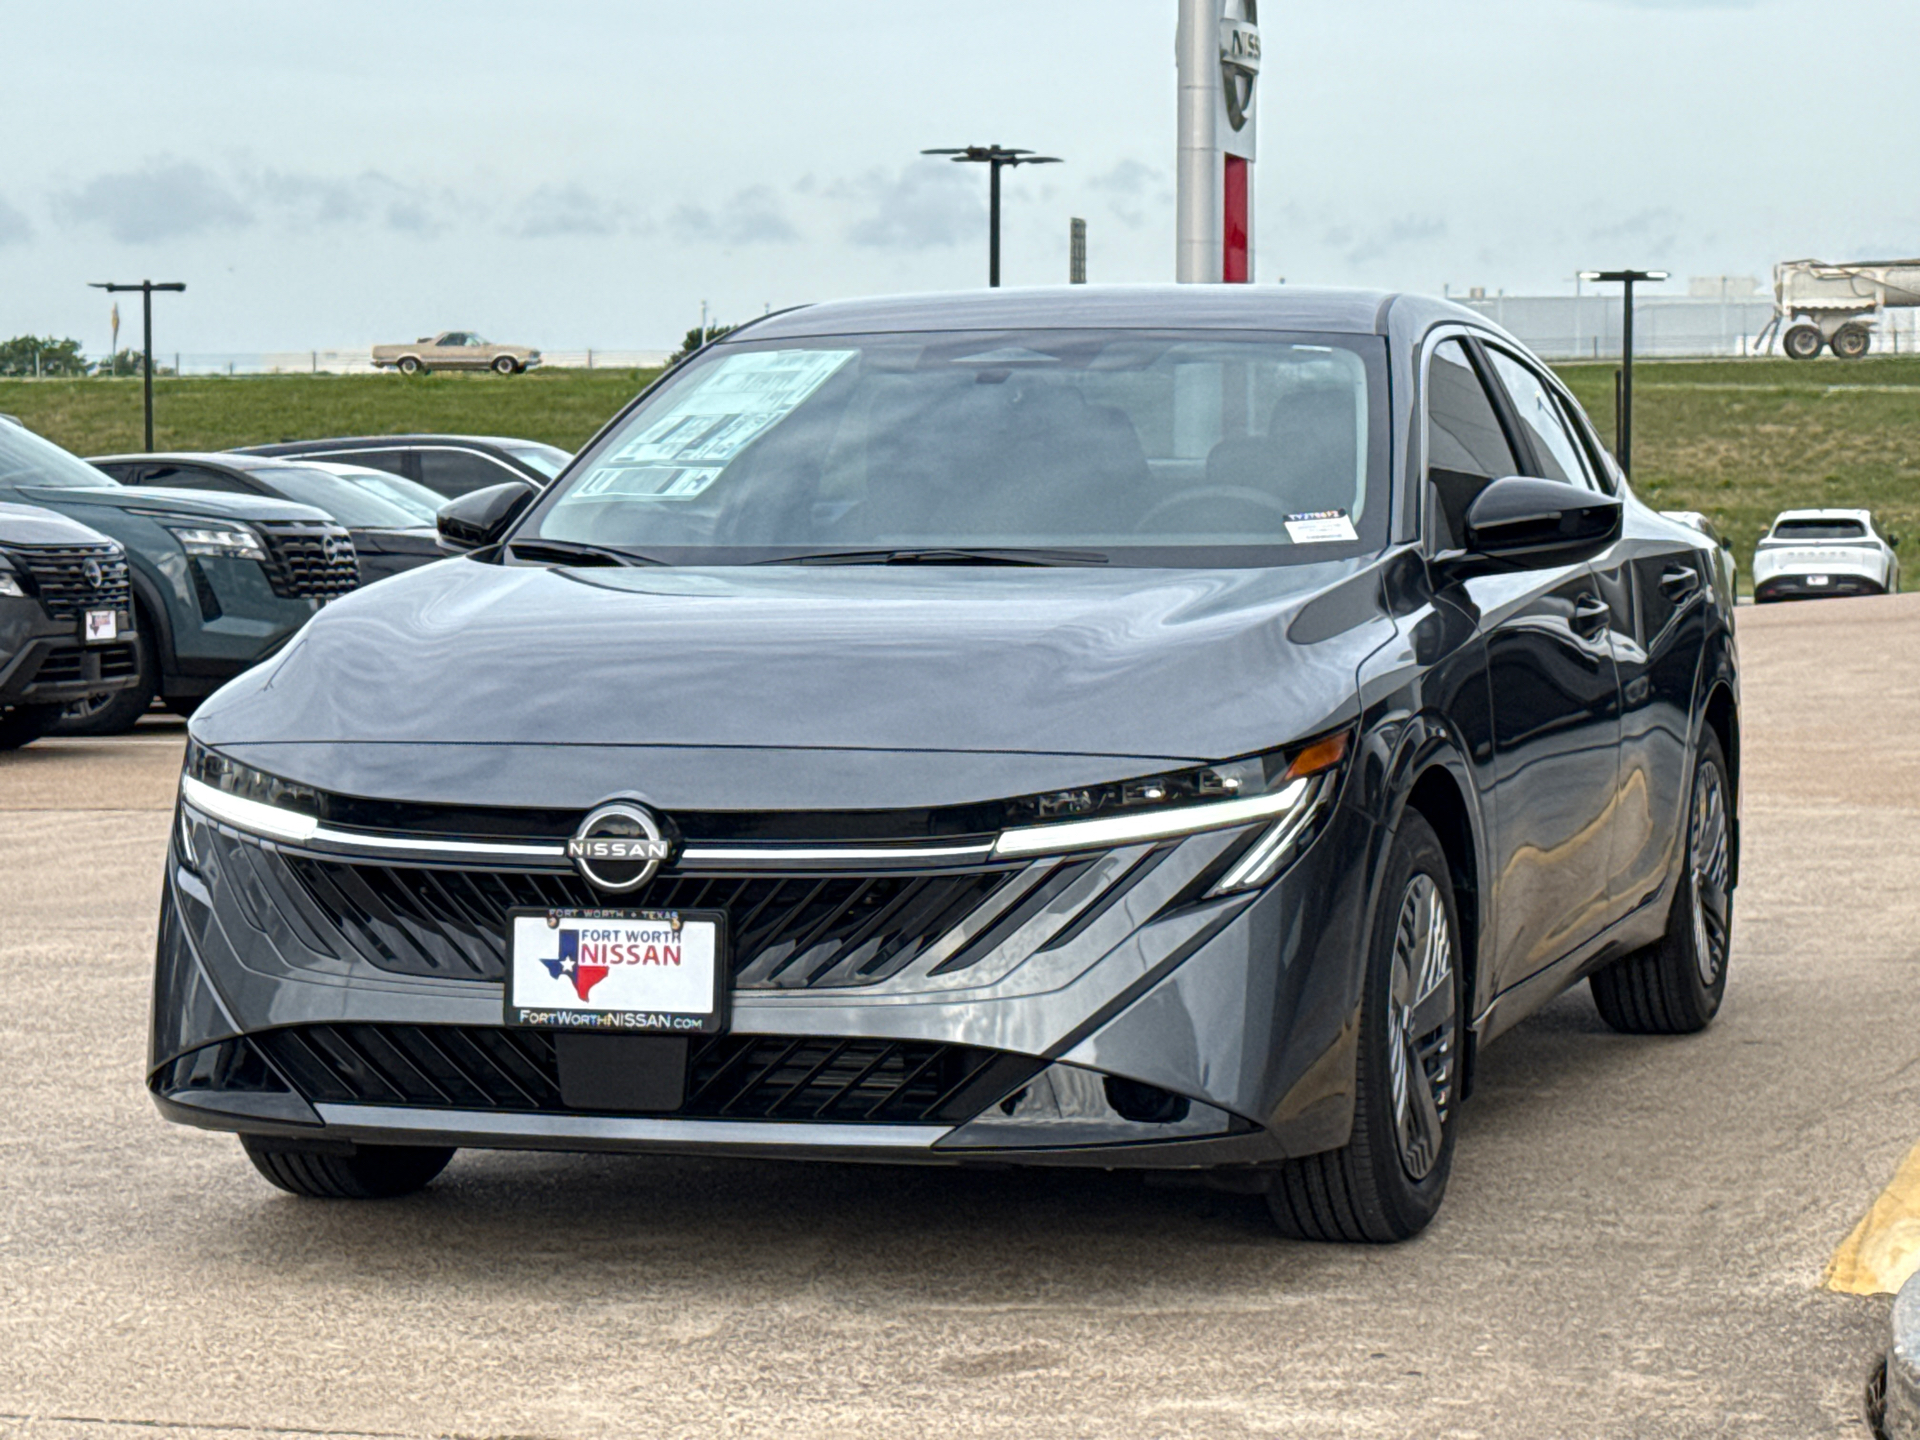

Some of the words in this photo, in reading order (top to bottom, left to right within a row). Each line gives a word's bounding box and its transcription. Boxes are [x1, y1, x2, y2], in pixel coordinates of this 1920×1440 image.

[569, 842, 665, 857] NISSAN
[548, 908, 579, 918] FORT
[583, 909, 624, 919] WORTH
[641, 910, 680, 920] TEXAS
[581, 929, 622, 943] FORT
[625, 930, 682, 944] WORTH
[581, 944, 681, 966] NISSAN
[519, 1009, 703, 1029] FORTWORTHNISSANCOM
